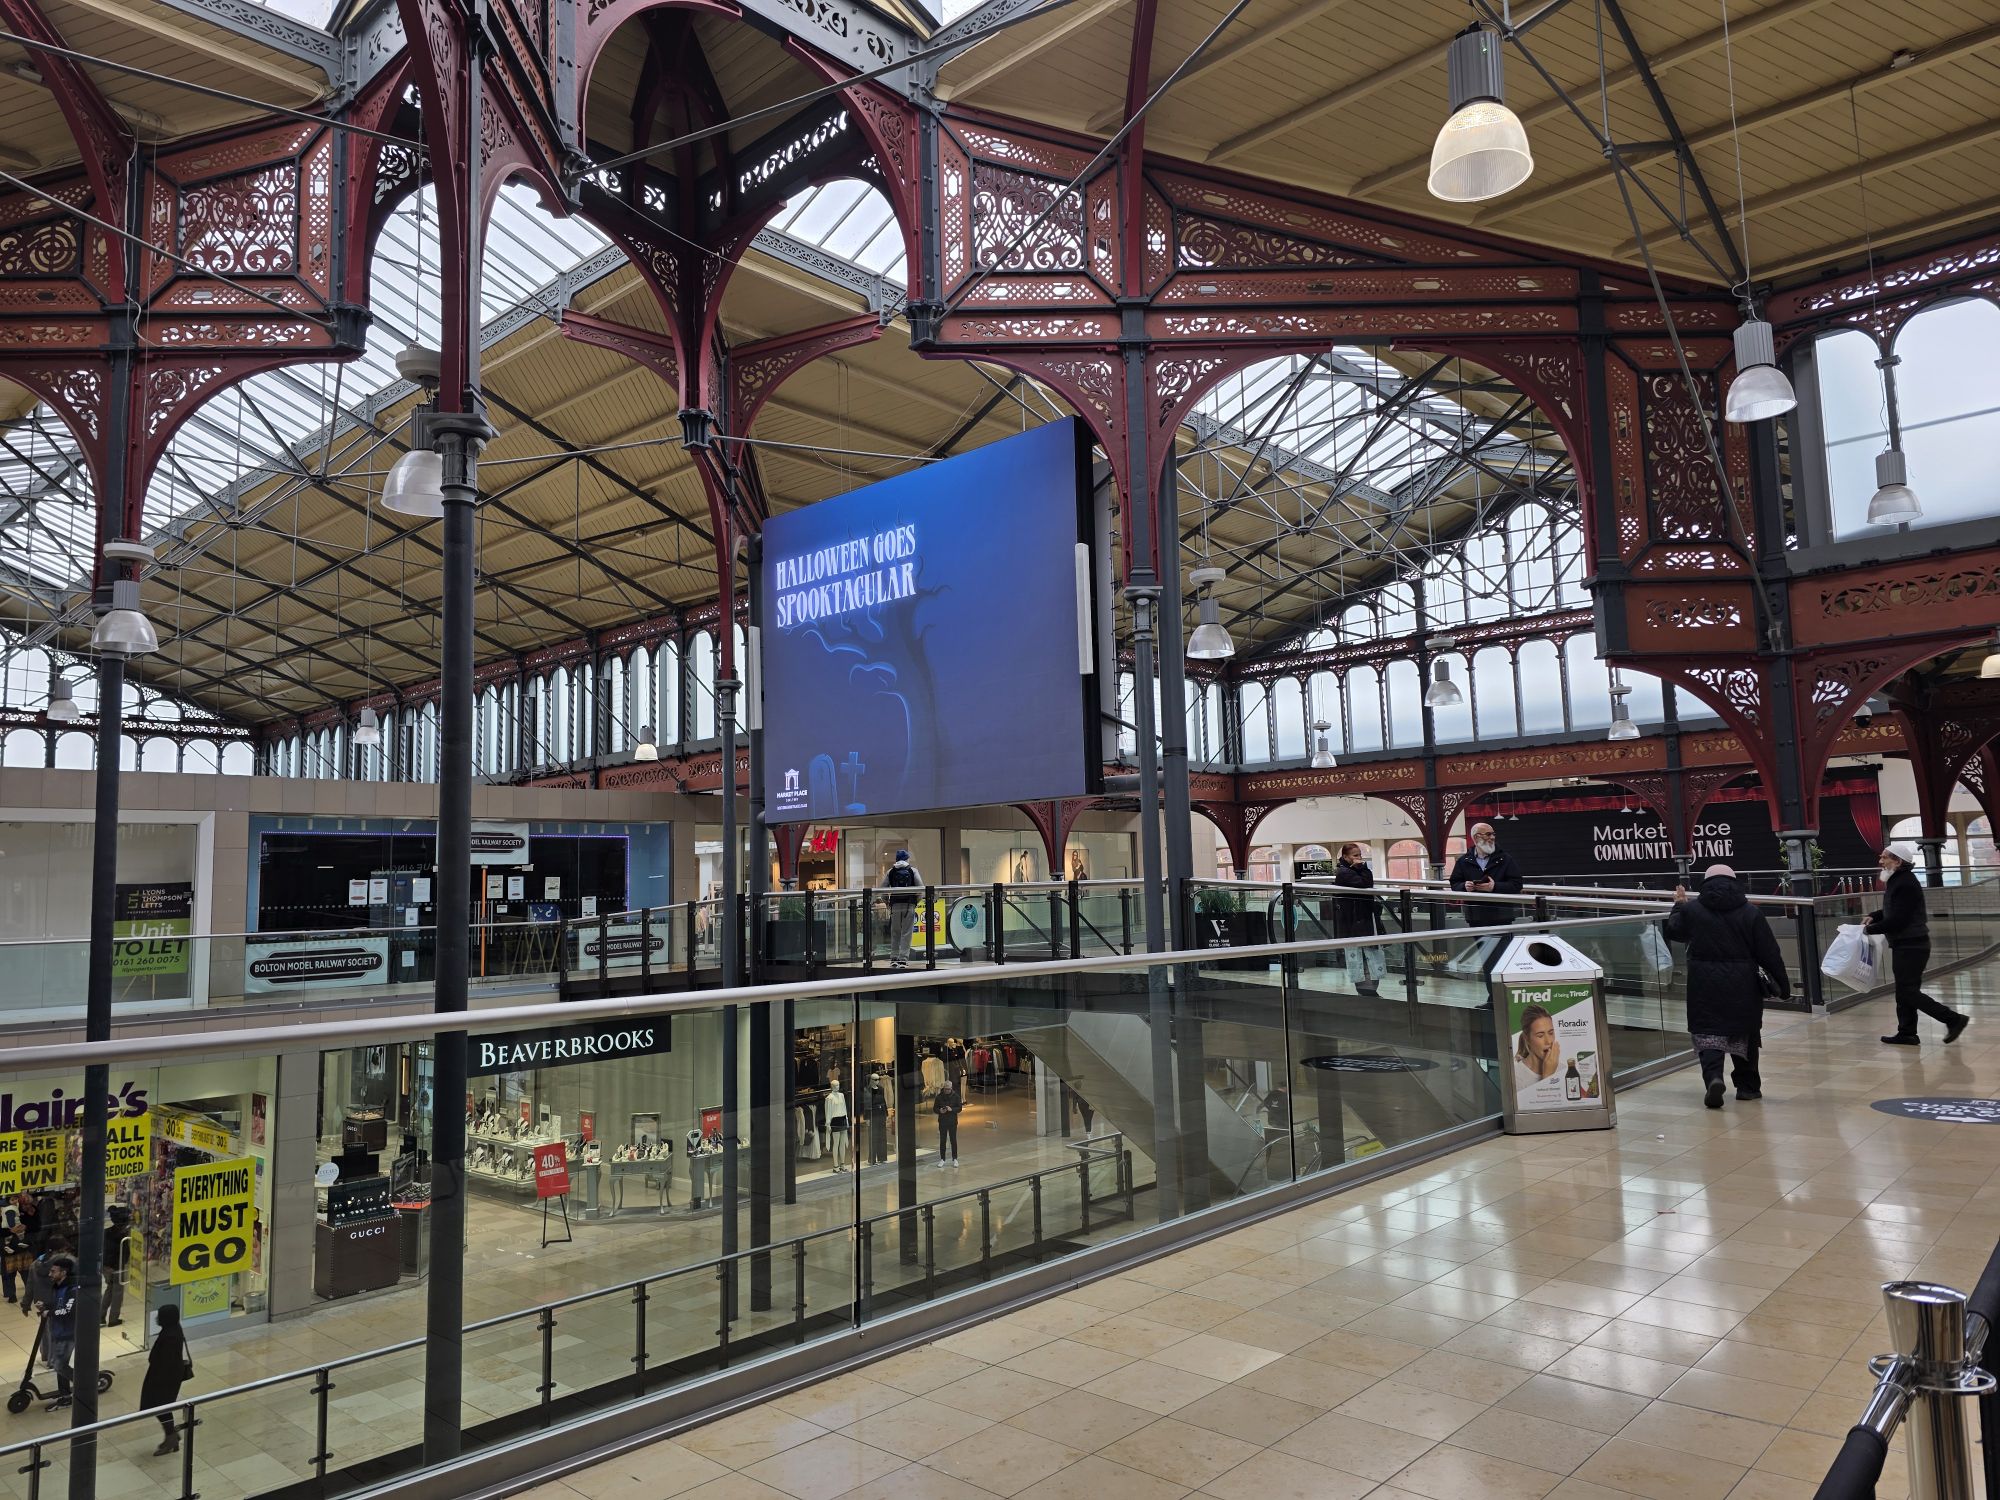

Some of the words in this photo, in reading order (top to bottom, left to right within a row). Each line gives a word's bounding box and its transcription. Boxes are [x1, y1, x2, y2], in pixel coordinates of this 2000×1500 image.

[776, 537, 869, 590] HALLOWEEN
[873, 523, 916, 563] GOES
[777, 562, 916, 628] SPOOKTACULAR
[1593, 823, 1667, 841] Market
[1692, 823, 1731, 836] ace
[809, 829, 839, 853] H&M
[141, 894, 183, 903] THOMPSON
[142, 888, 166, 896] LYONS
[130, 922, 175, 938] Unit
[113, 940, 144, 957] TO
[148, 938, 188, 955] LET
[586, 945, 600, 953] BOLT
[607, 942, 623, 950] MODEL
[623, 941, 642, 949] RAILWAY
[112, 958, 134, 967] 0161
[136, 957, 155, 966] 260
[156, 955, 180, 965] 0075
[254, 962, 286, 973] BOLTON
[287, 961, 314, 971] MODEL
[314, 958, 347, 969] RAILWAY
[347, 956, 378, 967] SOCIETY
[1511, 988, 1552, 1004] Tired
[1569, 990, 1589, 998] Tired?
[106, 1124, 145, 1145] ALL
[105, 1144, 144, 1161] STOCK
[180, 1167, 249, 1203] EVERYTHING
[179, 1202, 249, 1238] MUST
[349, 1226, 386, 1240] GUCCI
[177, 1236, 247, 1272] GO
